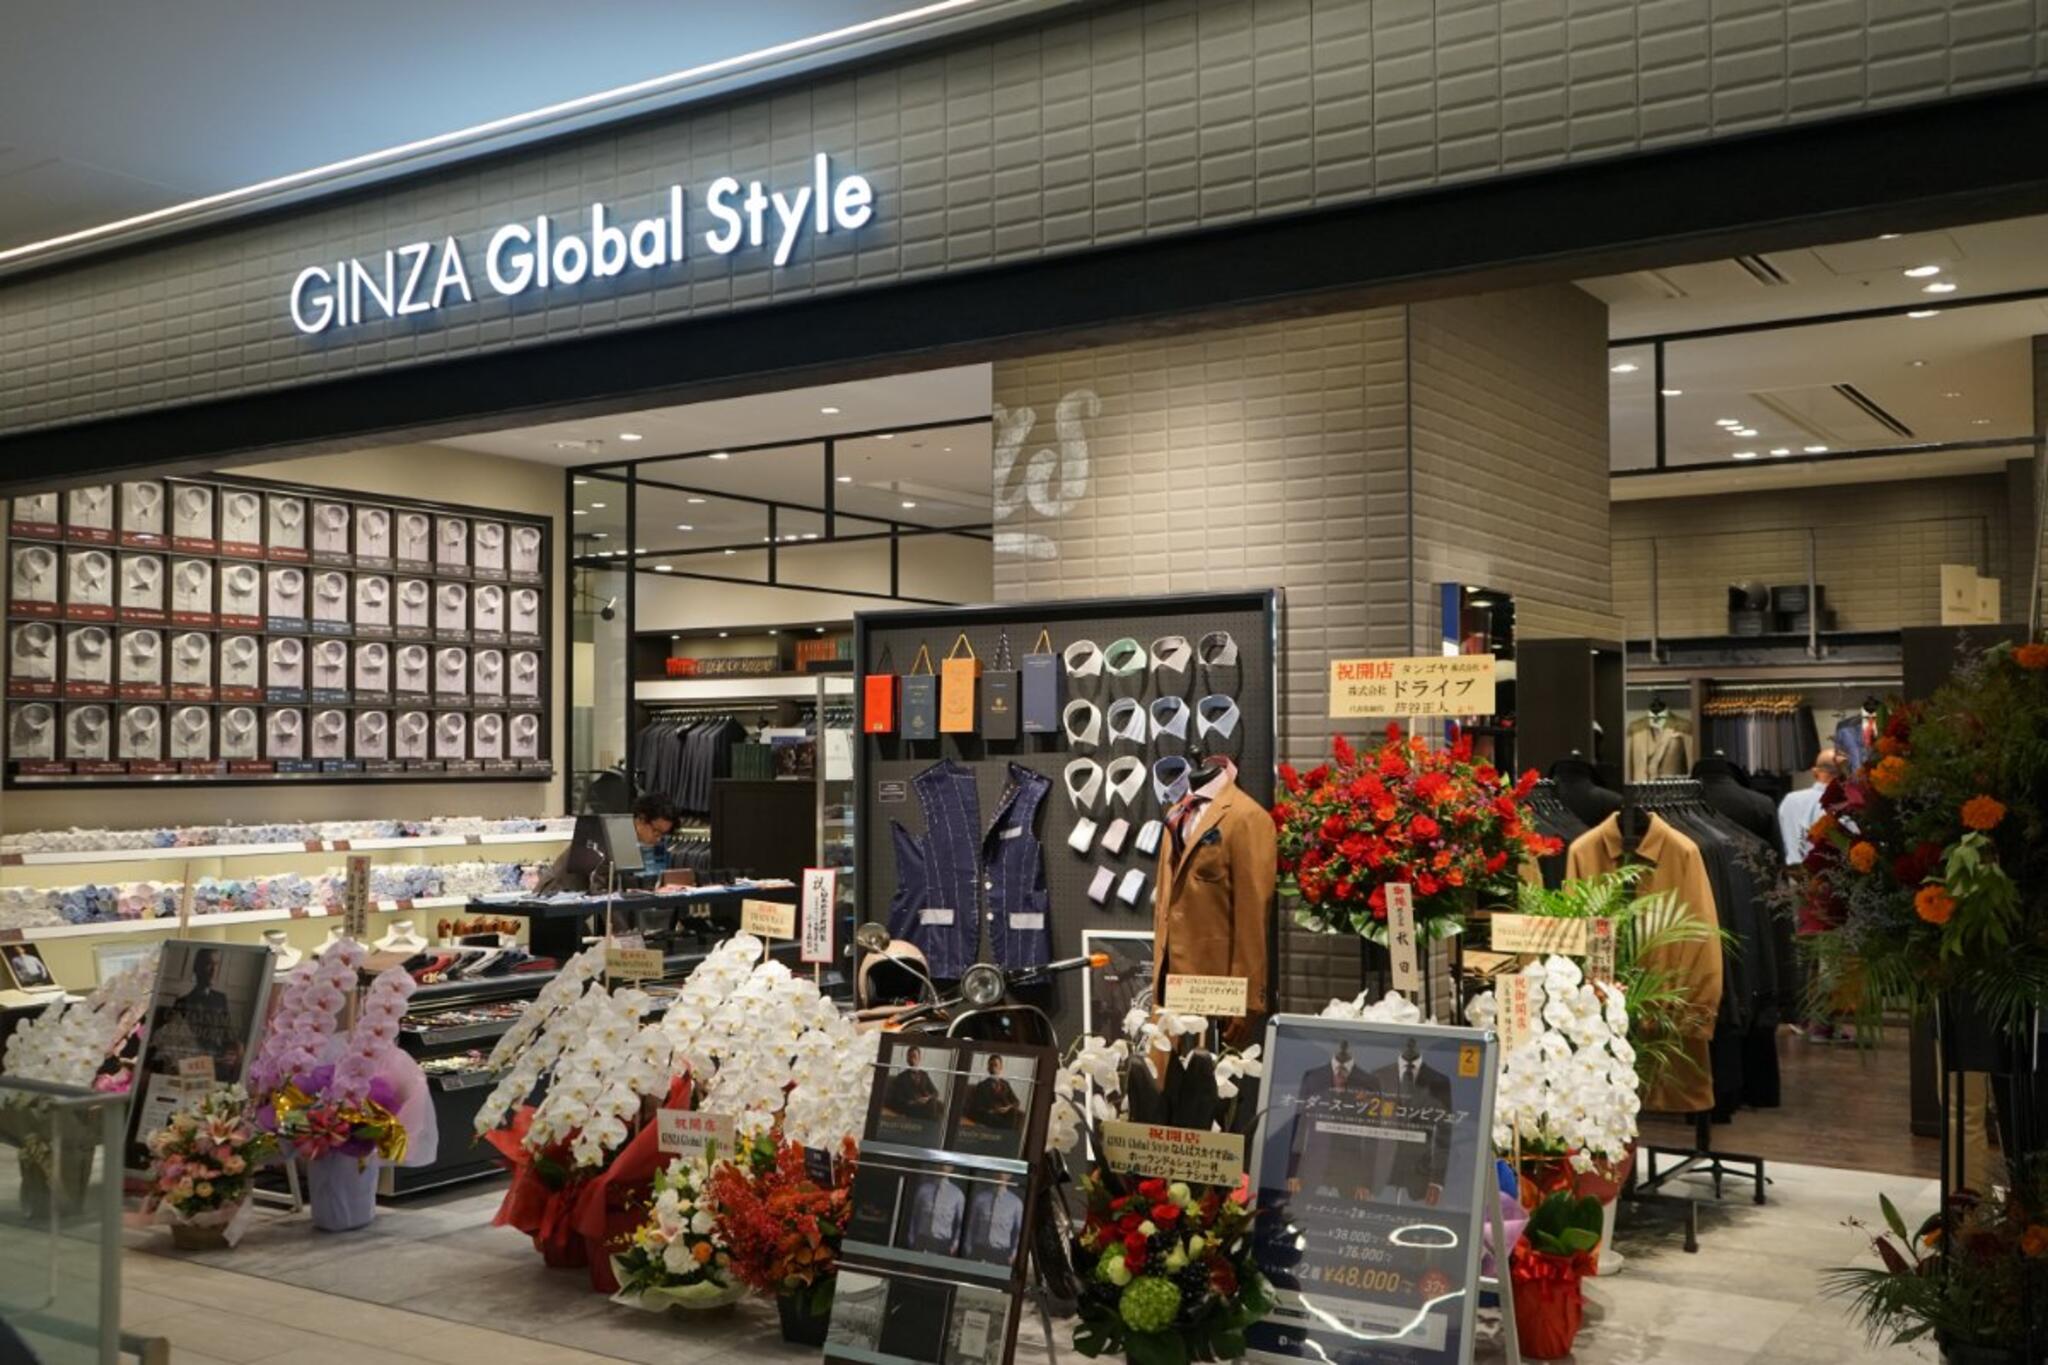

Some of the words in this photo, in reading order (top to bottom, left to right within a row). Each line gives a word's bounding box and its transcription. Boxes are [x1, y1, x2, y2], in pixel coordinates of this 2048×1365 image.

[290, 236, 472, 334] GINZA
[486, 185, 684, 296] Global
[704, 152, 874, 266] Style
[1337, 661, 1394, 680] 祝開店
